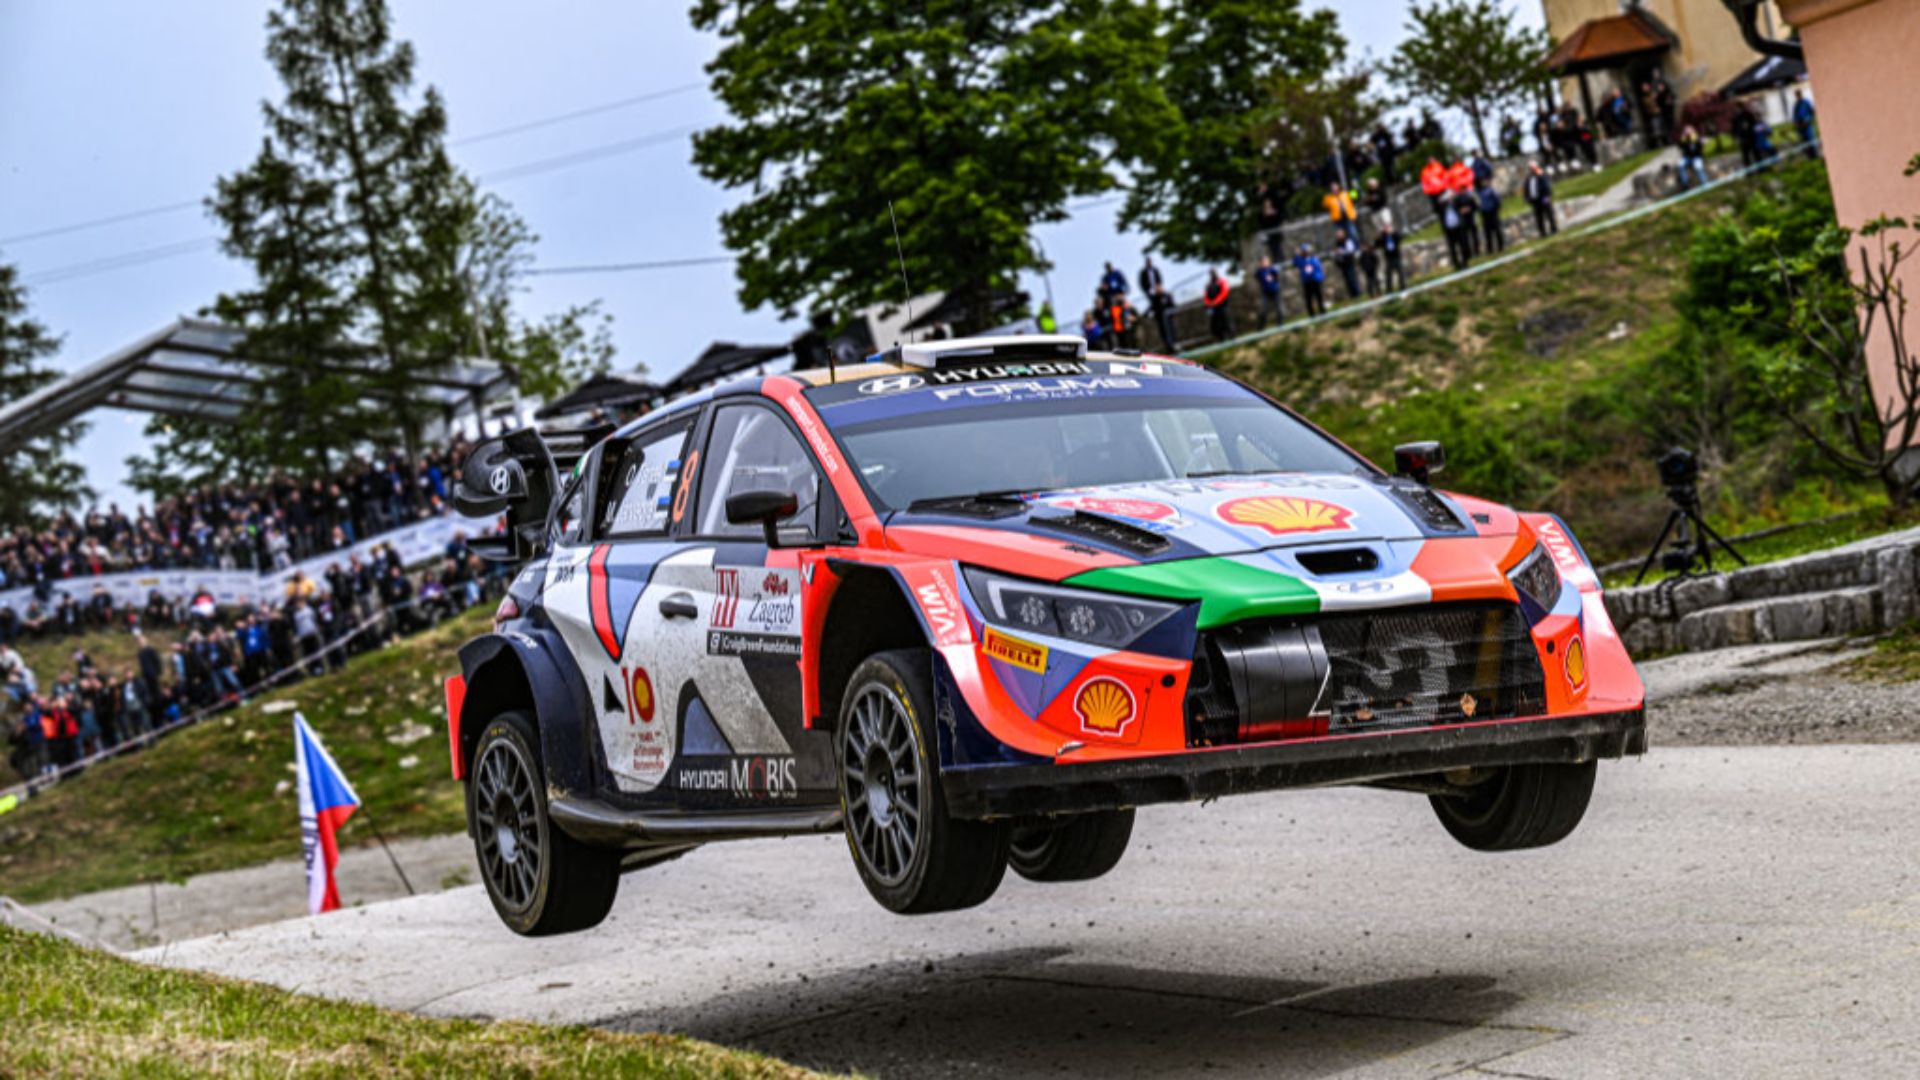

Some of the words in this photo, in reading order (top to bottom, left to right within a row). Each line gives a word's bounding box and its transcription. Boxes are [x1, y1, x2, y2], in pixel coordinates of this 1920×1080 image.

[933, 362, 1092, 384] HYUNDAI
[673, 449, 698, 523] 8
[749, 592, 794, 626] Zagreb
[987, 634, 1043, 668] PIRELLI
[680, 769, 728, 790] HYUNDAI
[731, 756, 798, 799] MOBIS
